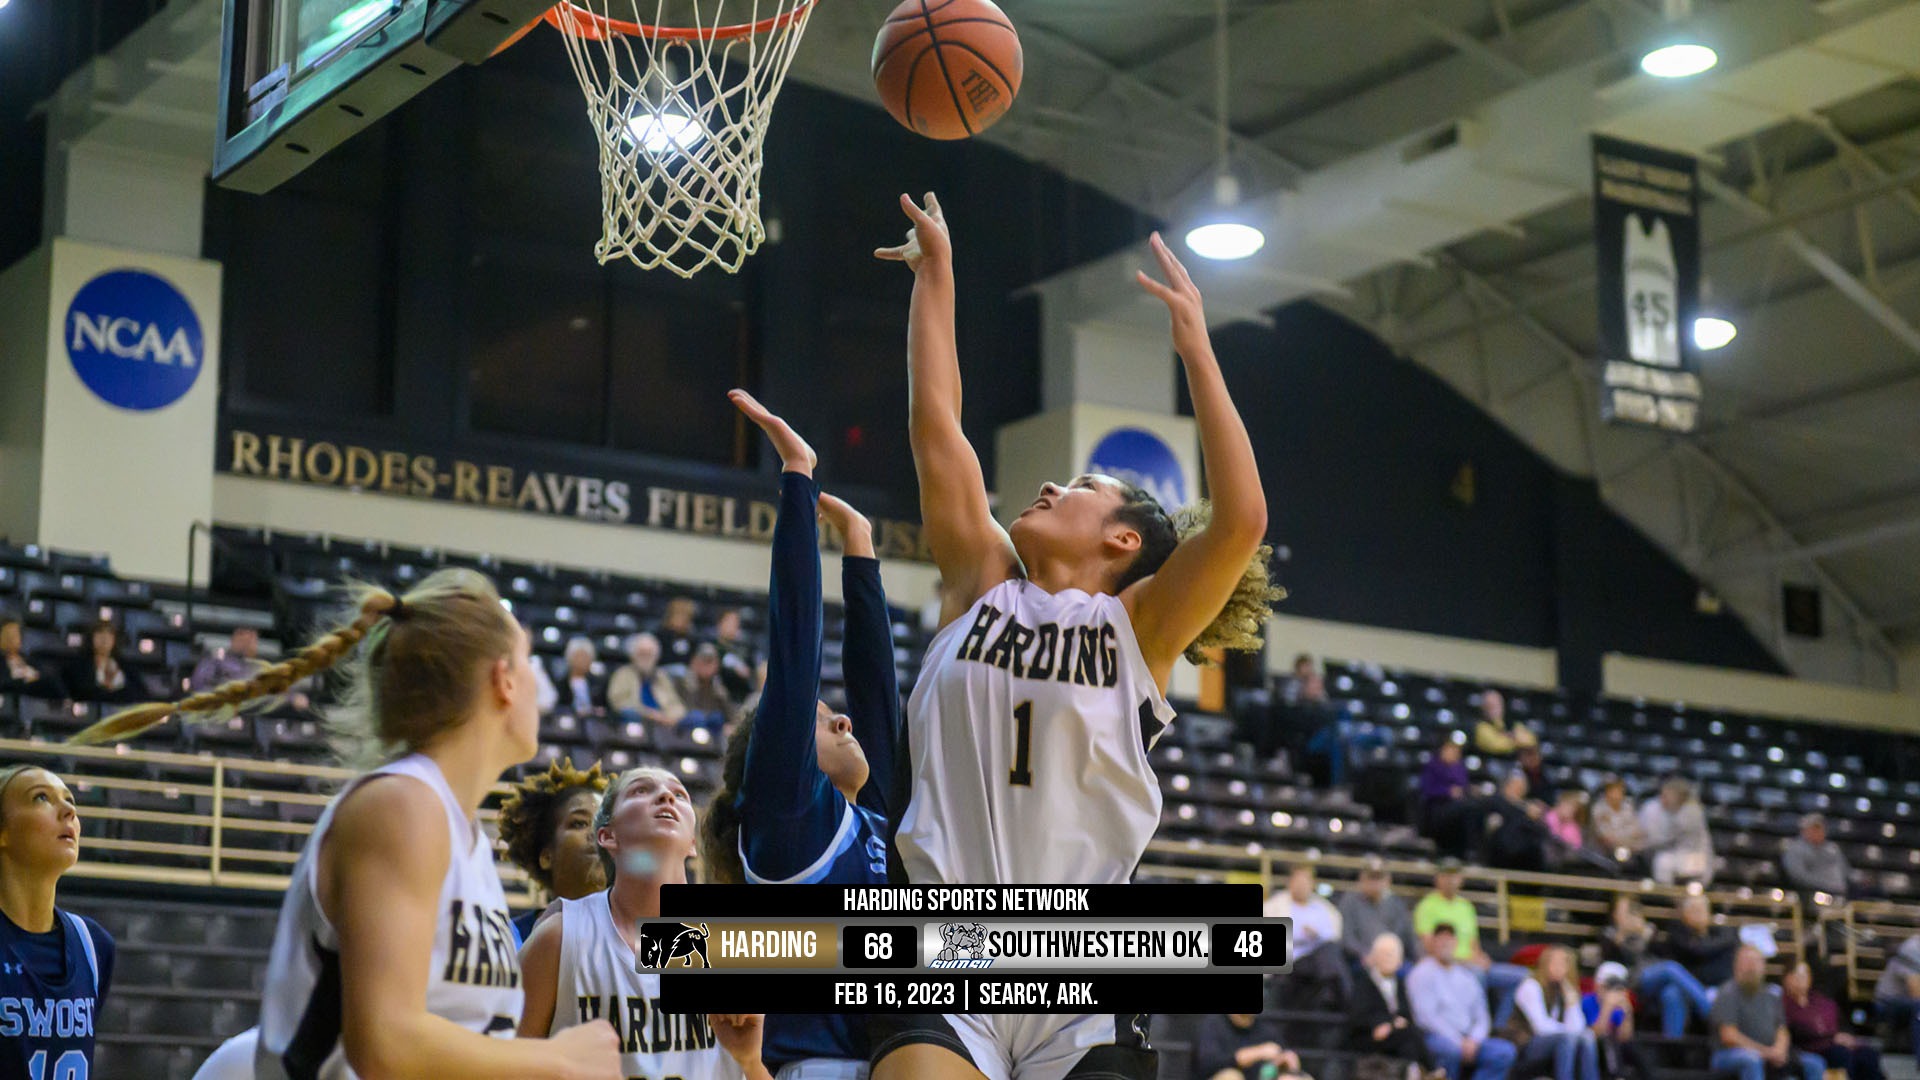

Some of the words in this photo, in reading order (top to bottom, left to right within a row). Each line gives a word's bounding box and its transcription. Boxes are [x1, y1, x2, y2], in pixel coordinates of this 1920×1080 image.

[72, 310, 196, 368] NCAA
[1632, 290, 1670, 331] 45
[232, 429, 631, 524] RHODES-REAVES
[647, 485, 781, 538] FIELD
[956, 603, 1119, 688] HARDING
[1009, 700, 1034, 788] 1
